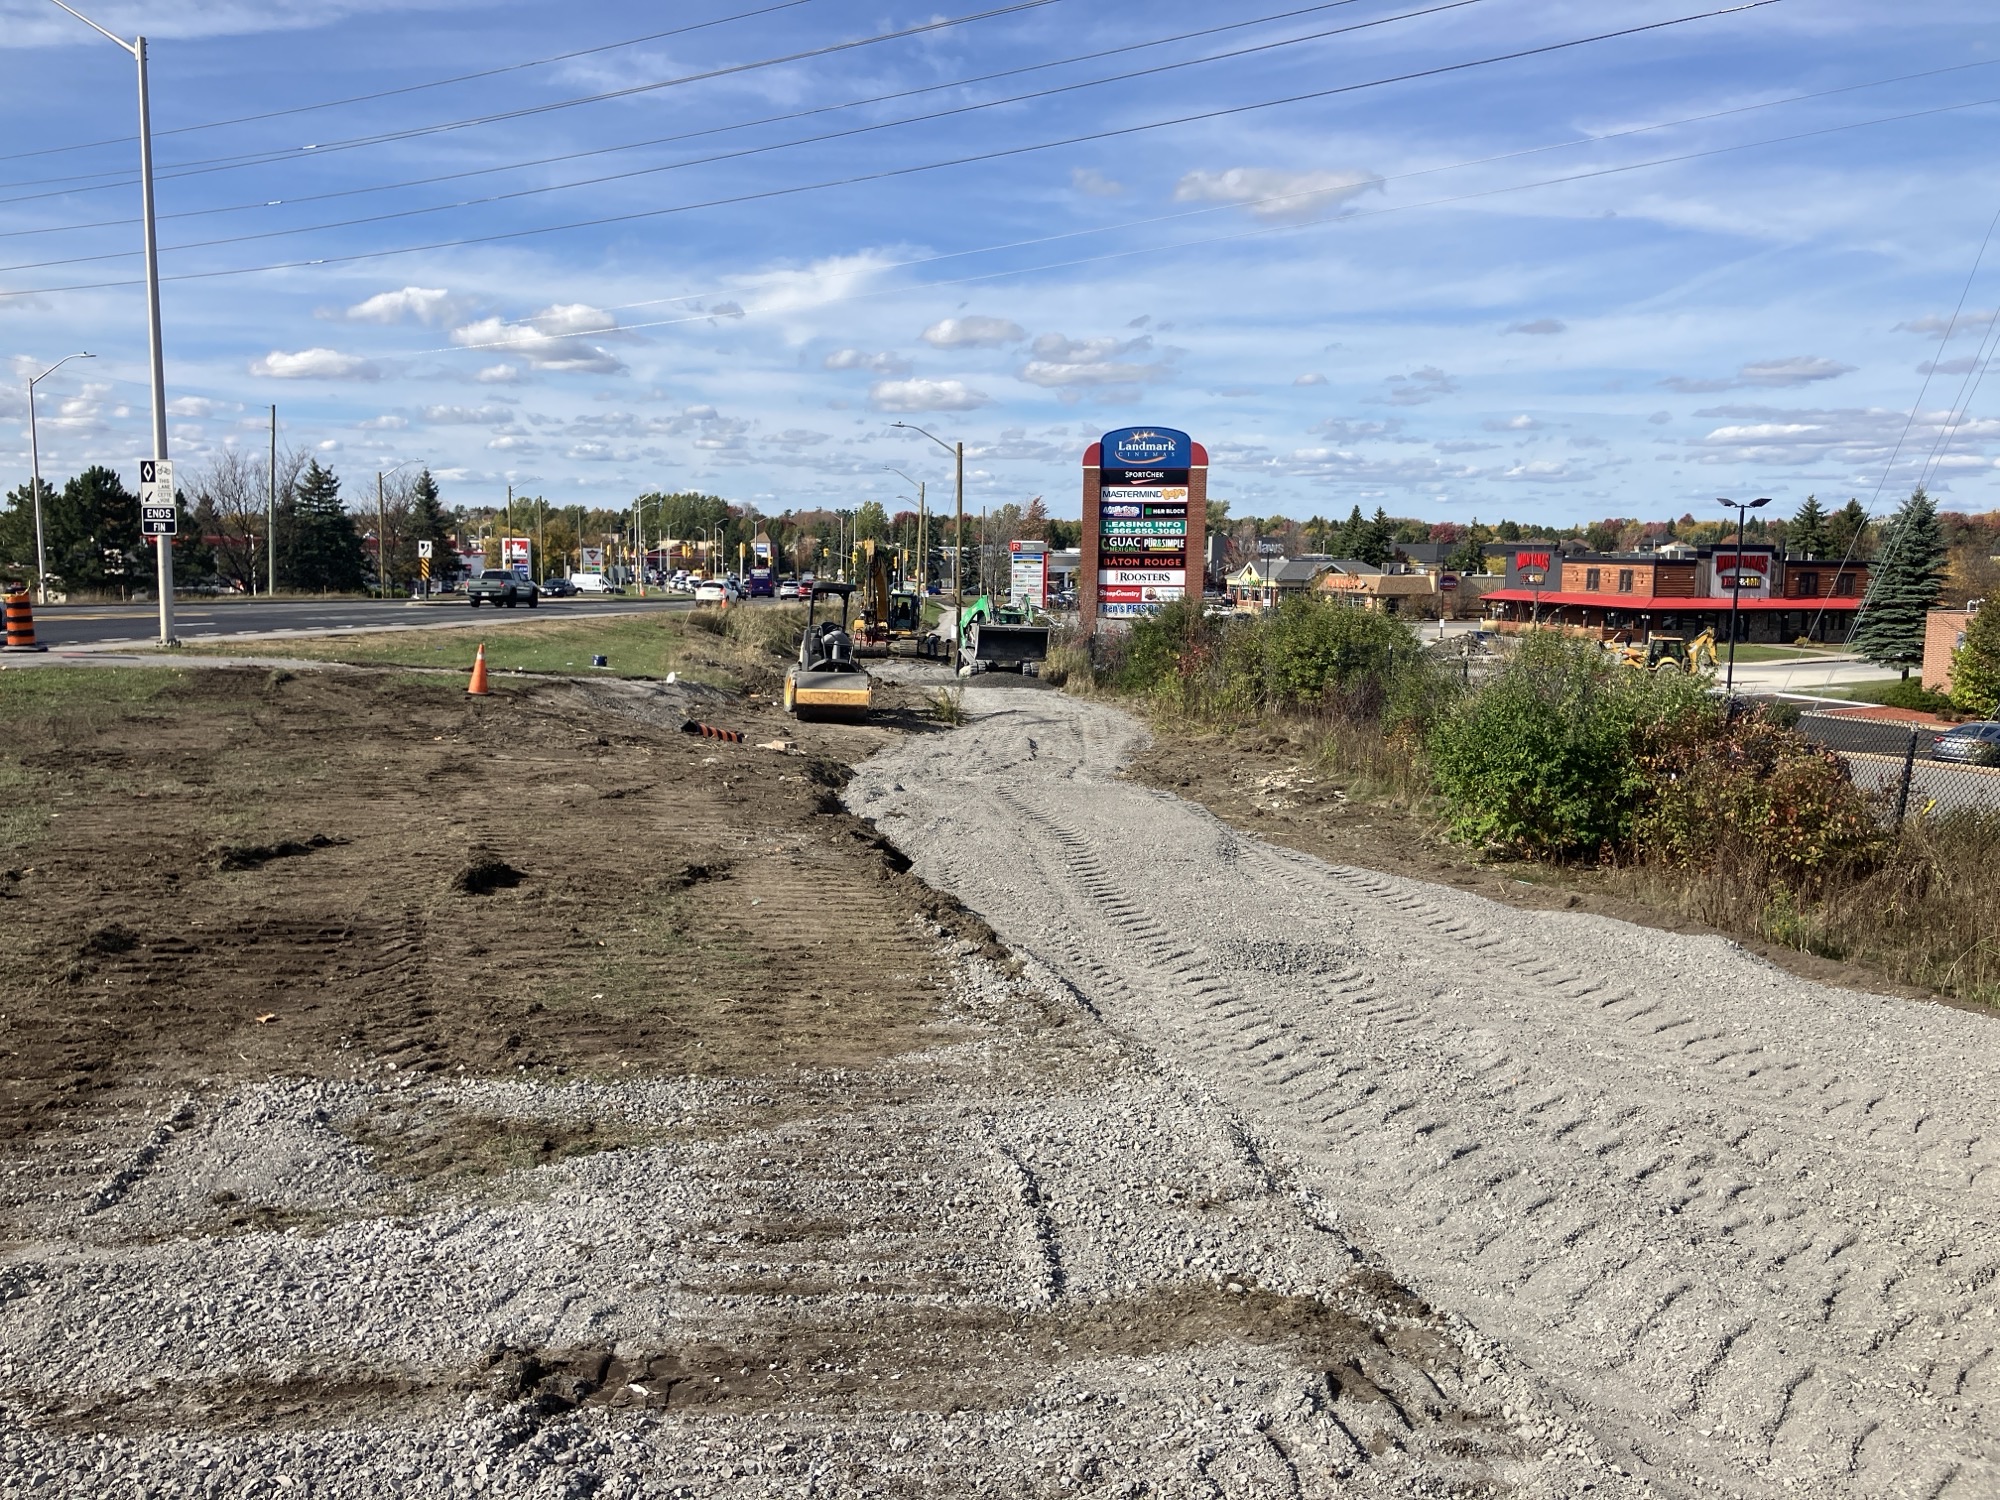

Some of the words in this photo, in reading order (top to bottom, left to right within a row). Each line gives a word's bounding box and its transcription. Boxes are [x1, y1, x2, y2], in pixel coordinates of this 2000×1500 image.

[1118, 441, 1175, 451] Landmark
[1102, 490, 1162, 498] MASTERMIND
[147, 508, 171, 518] ENDS
[154, 523, 166, 532] FIN
[1109, 537, 1141, 547] GUAC
[1144, 558, 1182, 566] ROUGE
[1120, 572, 1171, 582] ROOSTERS
[1102, 604, 1126, 613] Ren's
[1126, 604, 1147, 614] PETS
